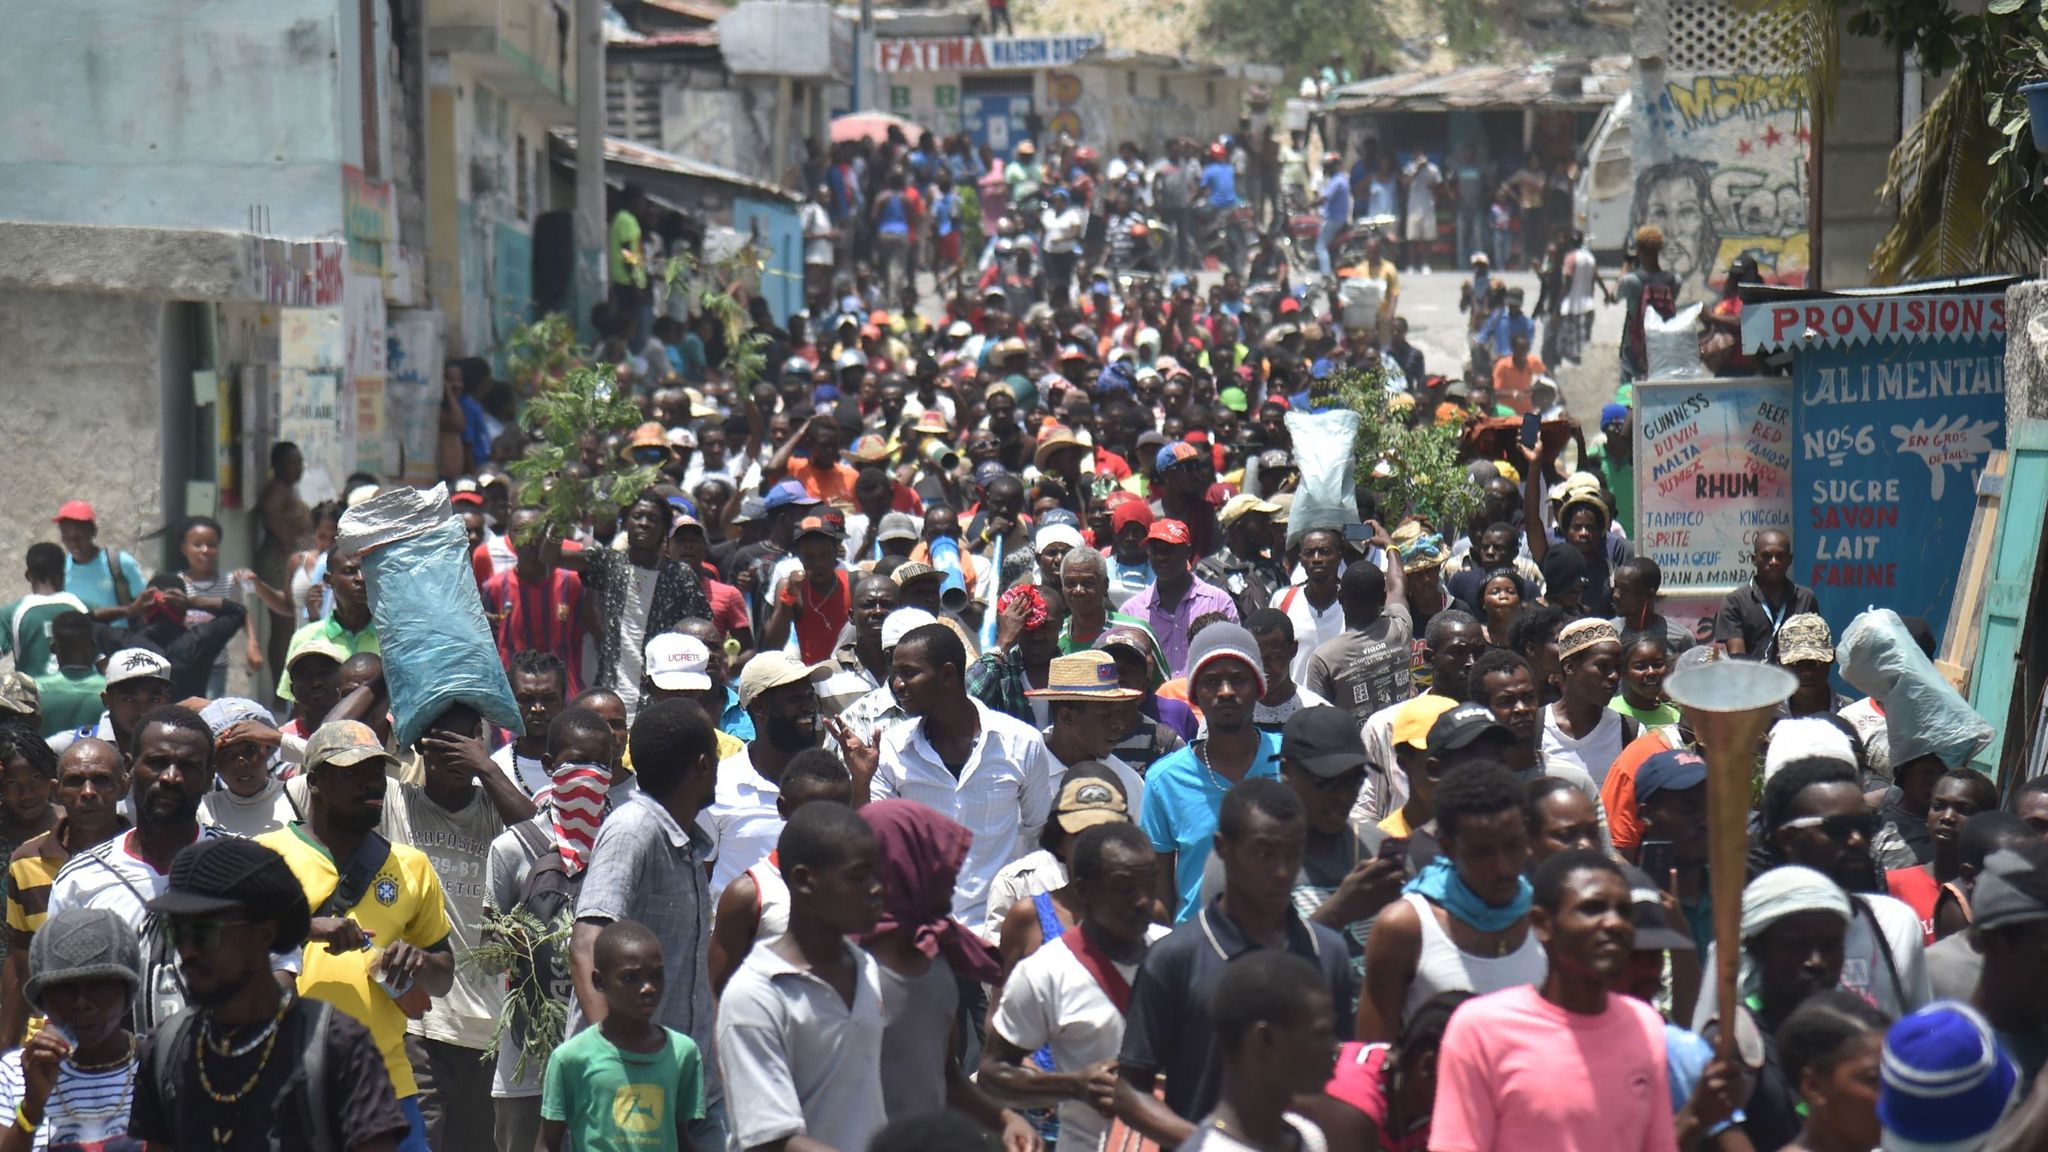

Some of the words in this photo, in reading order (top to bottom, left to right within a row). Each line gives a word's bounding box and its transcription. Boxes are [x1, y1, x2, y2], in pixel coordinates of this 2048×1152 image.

[1772, 300, 2006, 342] PROVISIONS
[1643, 392, 1711, 441] GUINNESS
[1757, 401, 1789, 426] BEER
[1752, 420, 1783, 443] RED
[1908, 434, 1929, 448] EN
[1933, 431, 1968, 447] GROS
[1653, 444, 1701, 481] MALTA
[1744, 439, 1791, 471] FAMOSA
[1658, 457, 1705, 498] JUMEX
[1744, 456, 1778, 484] TORO
[1695, 472, 1759, 499] RHUM
[1812, 478, 1900, 504] SUCRE
[1646, 511, 1704, 528] TAMPICO
[1810, 505, 1898, 529] SAVON
[1647, 530, 1691, 548] SPRITE
[1816, 535, 1880, 560] LAIT
[1652, 552, 1680, 567] PAIN
[1663, 571, 1692, 586] PAIN
[1695, 571, 1704, 584] A
[1810, 562, 1898, 589] FARINE
